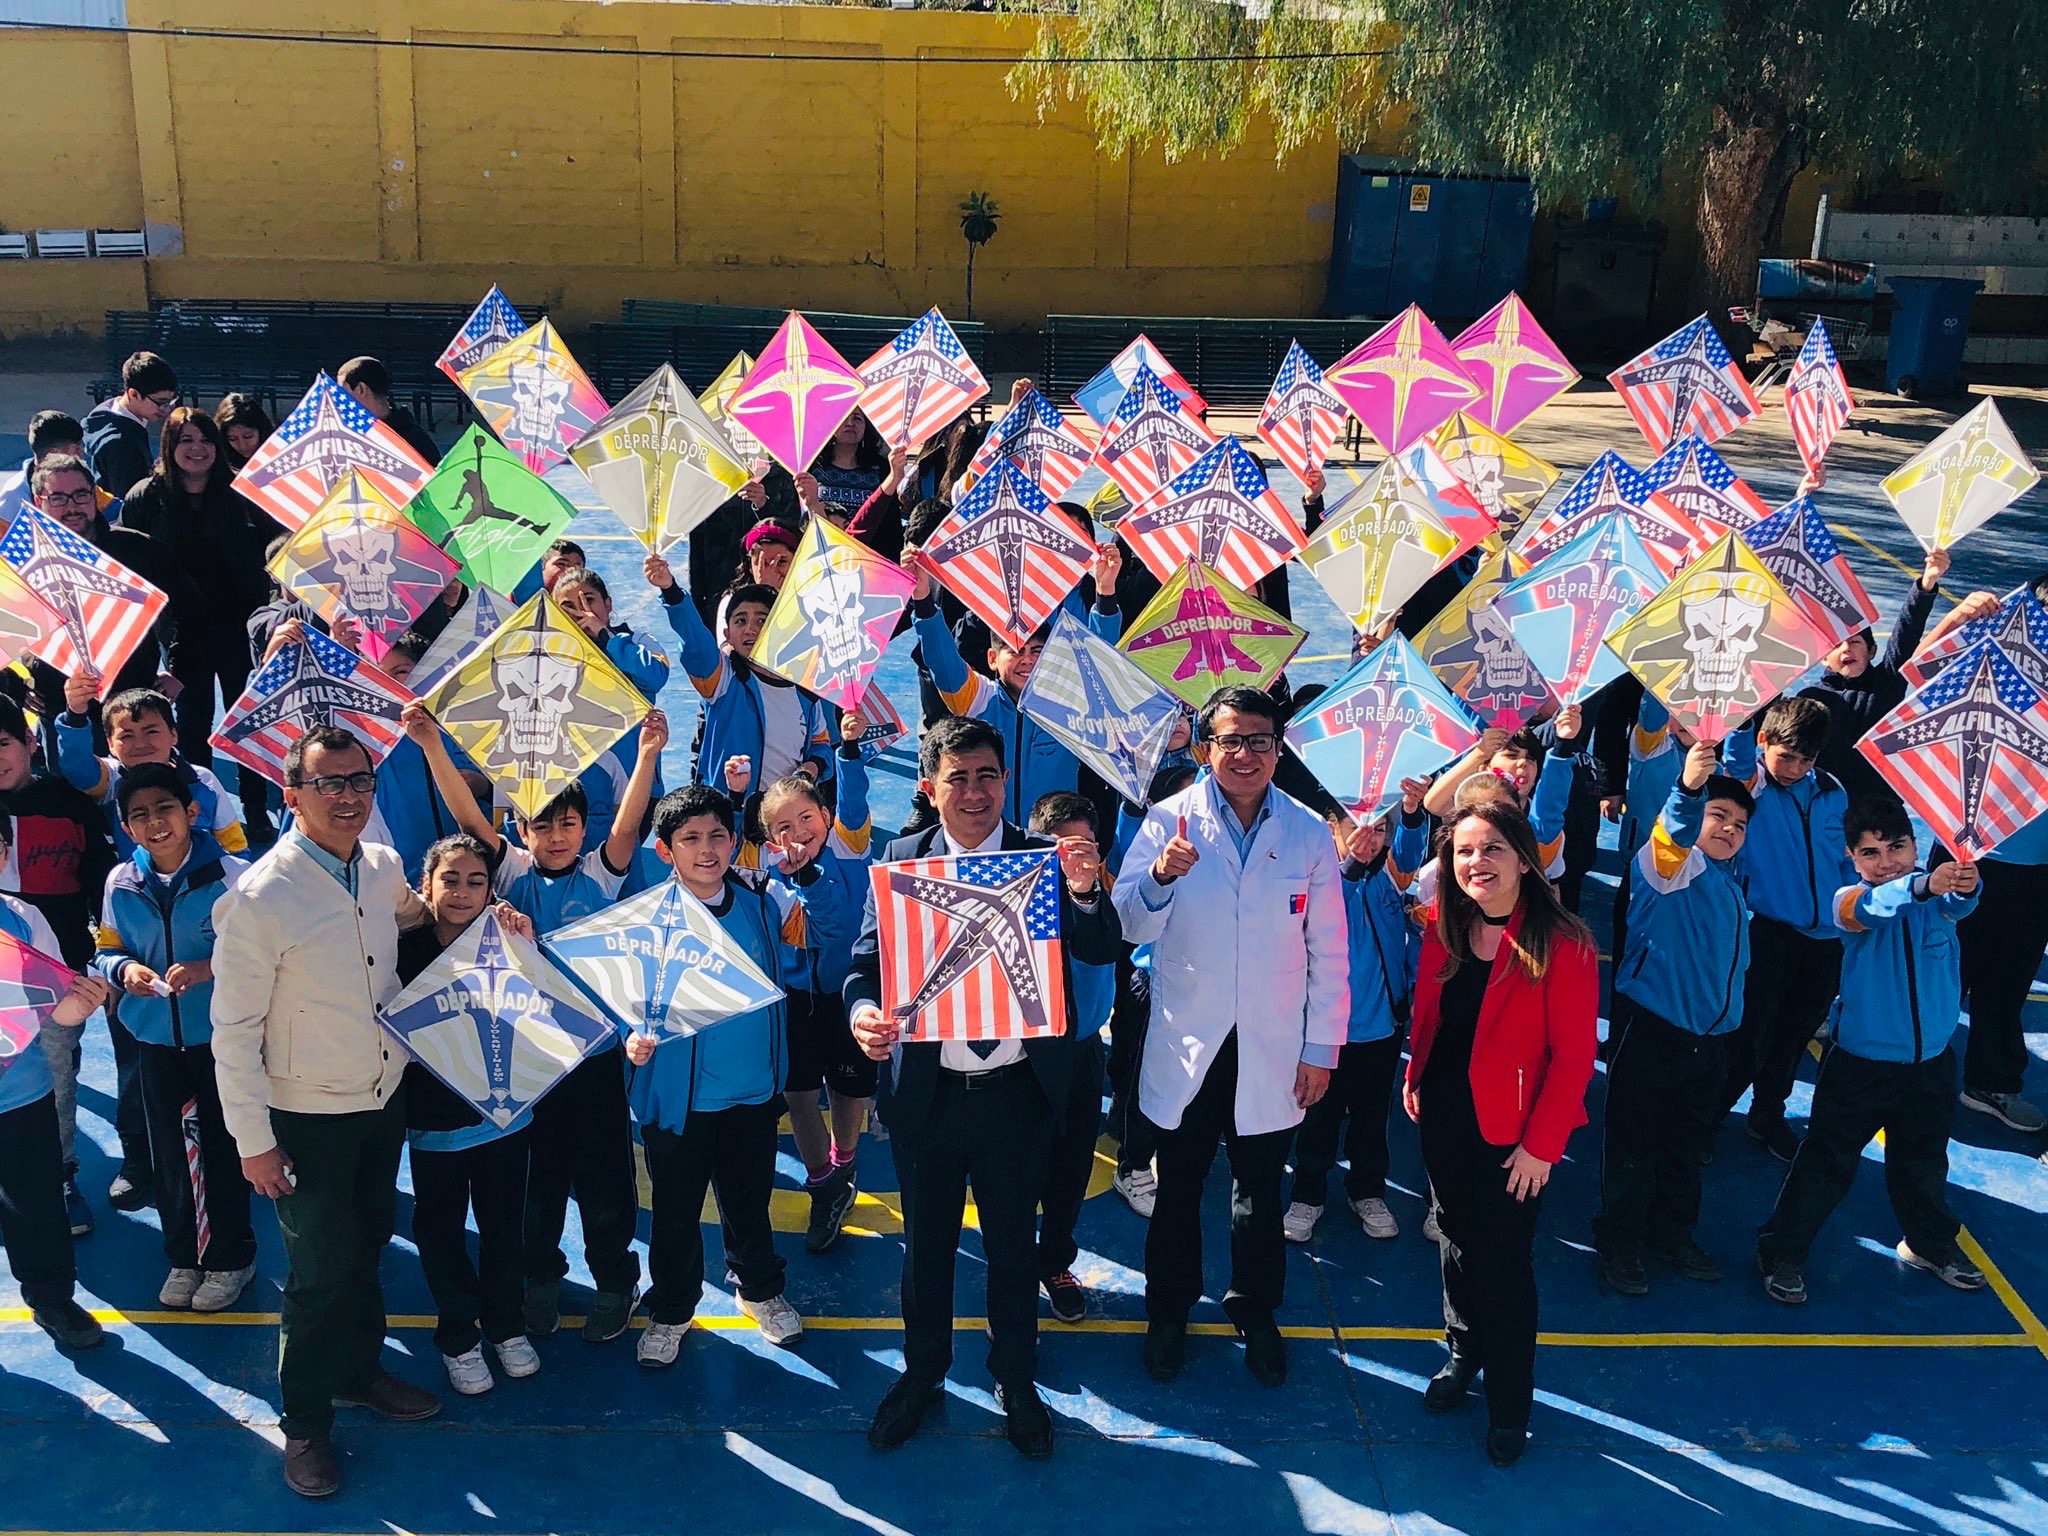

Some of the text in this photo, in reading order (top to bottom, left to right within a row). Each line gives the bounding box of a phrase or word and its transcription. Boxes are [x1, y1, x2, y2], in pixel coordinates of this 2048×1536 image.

[1662, 363, 1716, 392] ALFILES
[1134, 417, 1182, 443] ALFILES
[300, 437, 369, 465] ALFILES
[613, 432, 710, 464] DEPREDADOR
[1182, 498, 1250, 528] ALFILES
[977, 516, 1043, 543] ALFILES
[1340, 518, 1423, 544] DEPREDADOR
[1161, 614, 1253, 640] DEPREDADOR
[1386, 655, 1402, 664] CLUB
[278, 685, 353, 716] ALFILES
[1067, 711, 1150, 735] DEPREDADOR
[1333, 705, 1437, 730] DEPREDADOR
[1936, 710, 2021, 747] ALFILES
[662, 900, 681, 911] CLUB
[482, 936, 500, 946] CLUB
[948, 897, 1021, 966] ALFILES
[603, 935, 727, 975] DEPREDADOR
[433, 990, 555, 1015] DEPREDADOR
